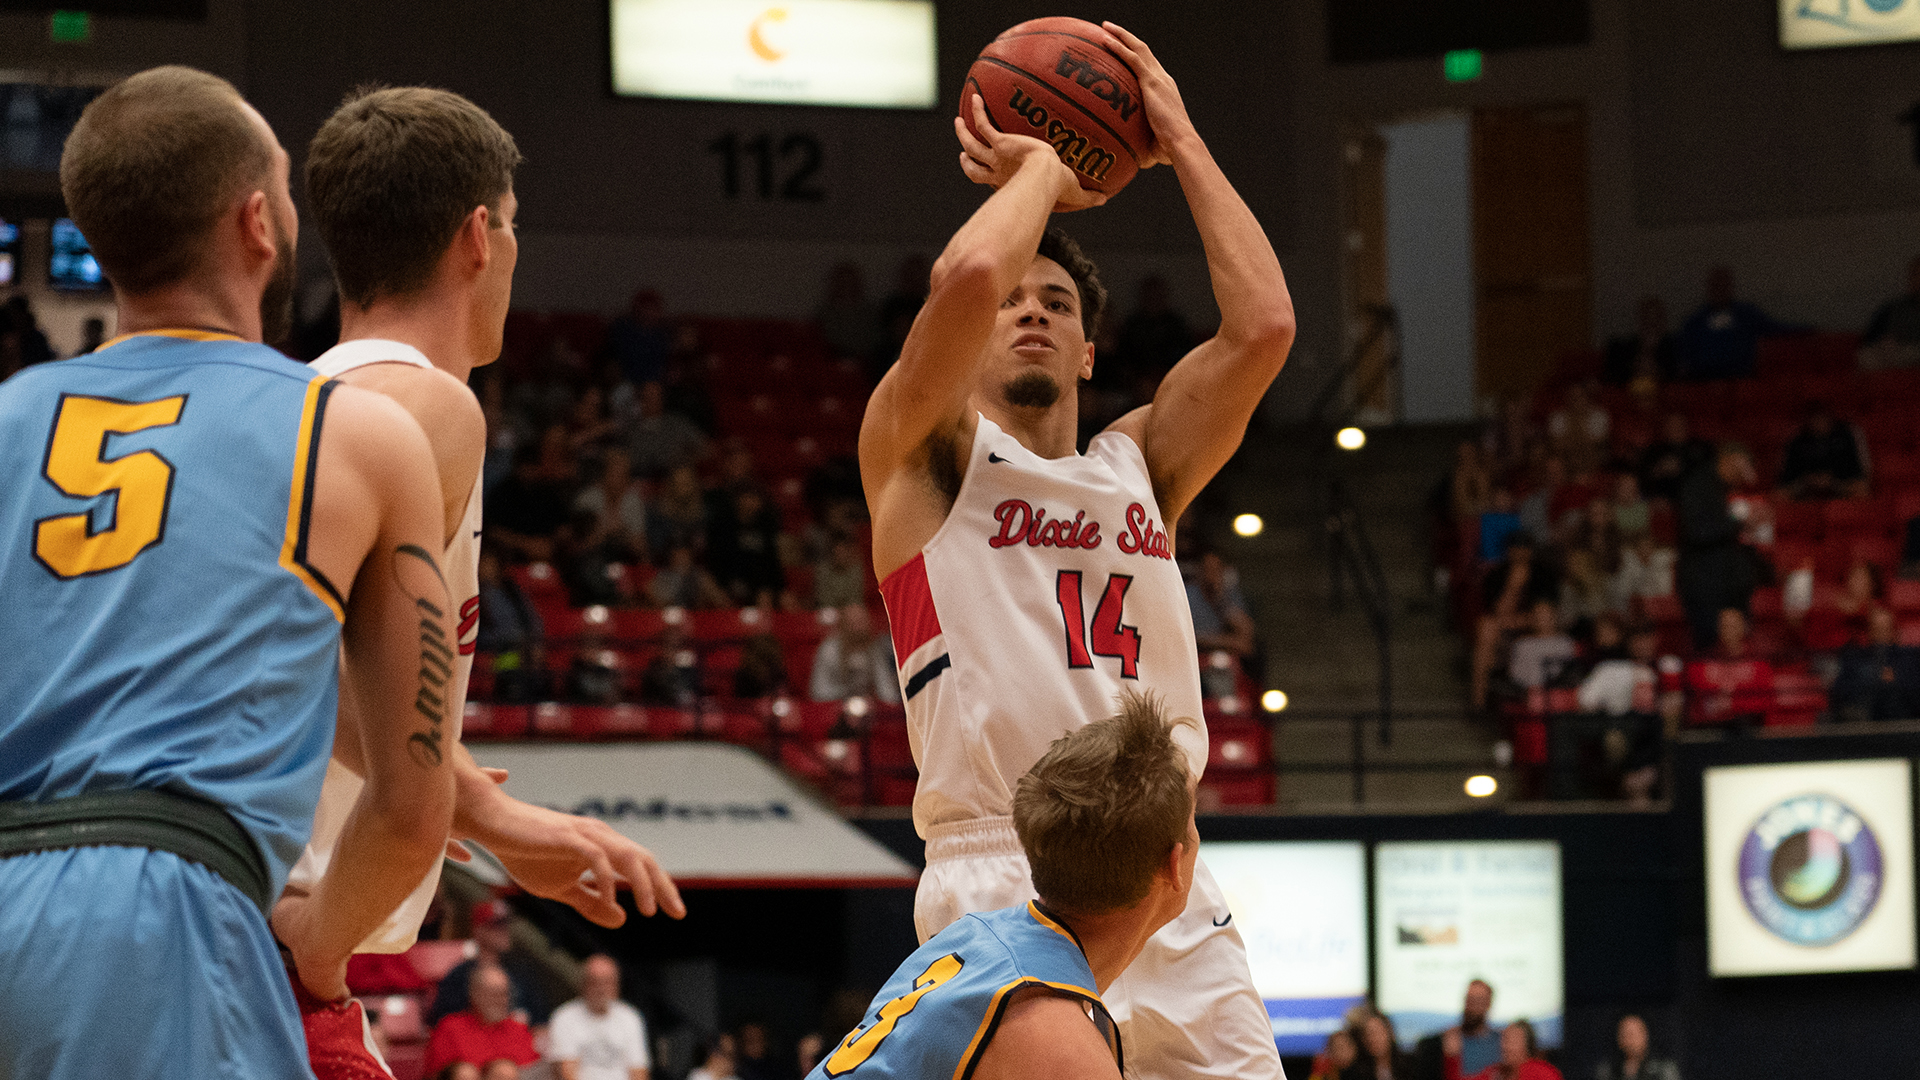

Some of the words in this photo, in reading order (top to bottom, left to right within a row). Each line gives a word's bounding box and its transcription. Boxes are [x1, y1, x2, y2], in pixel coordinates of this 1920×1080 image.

[1055, 50, 1139, 123] NCAA
[708, 134, 822, 200] 112
[1009, 87, 1117, 183] Wilson
[31, 392, 190, 581] 5
[988, 499, 1102, 550] Dixie
[1056, 569, 1142, 681] 14
[823, 951, 965, 1080] 3
